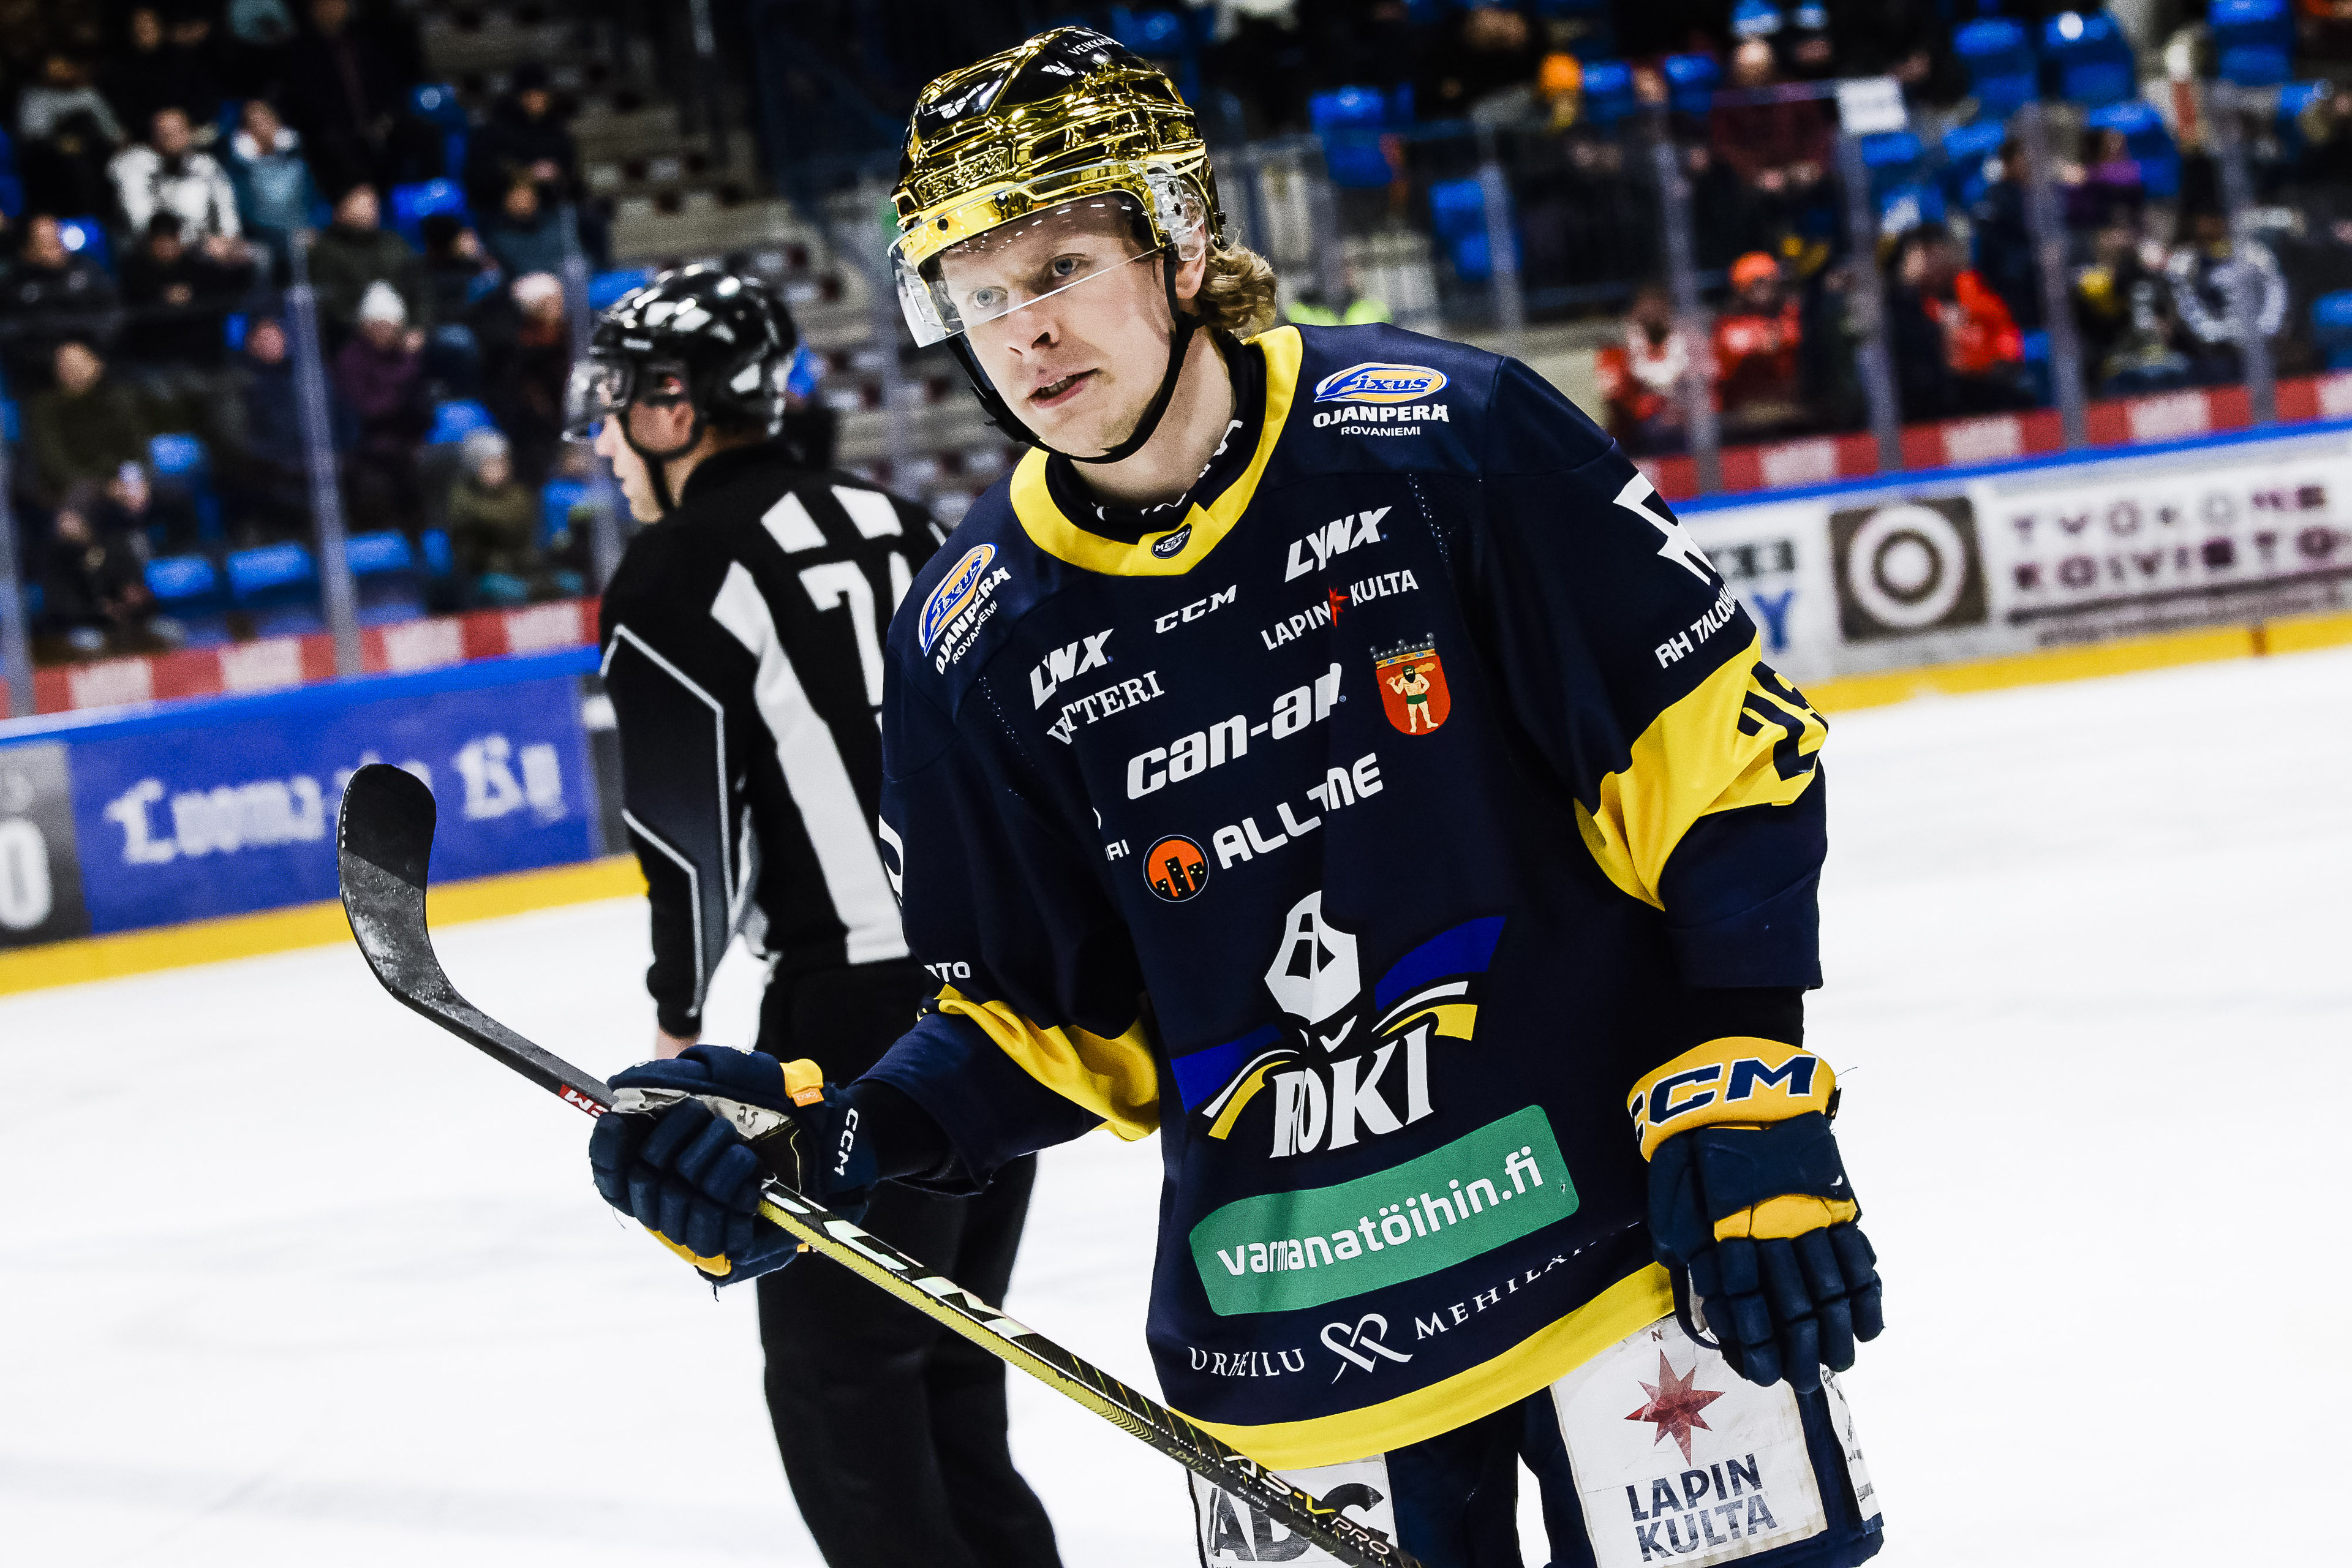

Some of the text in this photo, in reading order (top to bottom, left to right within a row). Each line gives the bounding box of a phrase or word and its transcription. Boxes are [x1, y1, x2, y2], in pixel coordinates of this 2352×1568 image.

[1068, 37, 1114, 55] VEIKKAU
[1314, 368, 1436, 402] Fixus
[1313, 404, 1449, 428] OJANPERÄ
[1341, 426, 1420, 437] ROVANIEMI
[1285, 506, 1392, 582] LYNX
[924, 546, 989, 657] Fixus
[1155, 584, 1236, 633] CCM
[1261, 570, 1419, 650] LAPIN KULTA
[1654, 630, 1695, 669] RH
[1269, 1023, 1434, 1159] ROKI
[834, 1107, 859, 1177] CCM
[1216, 1145, 1543, 1276] varmanatöihin.fi
[1187, 1346, 1305, 1377] URHEILU
[1626, 1453, 1763, 1522] LAPIN
[1330, 1517, 1390, 1555] PRO
[1635, 1494, 1778, 1562] KULTA
